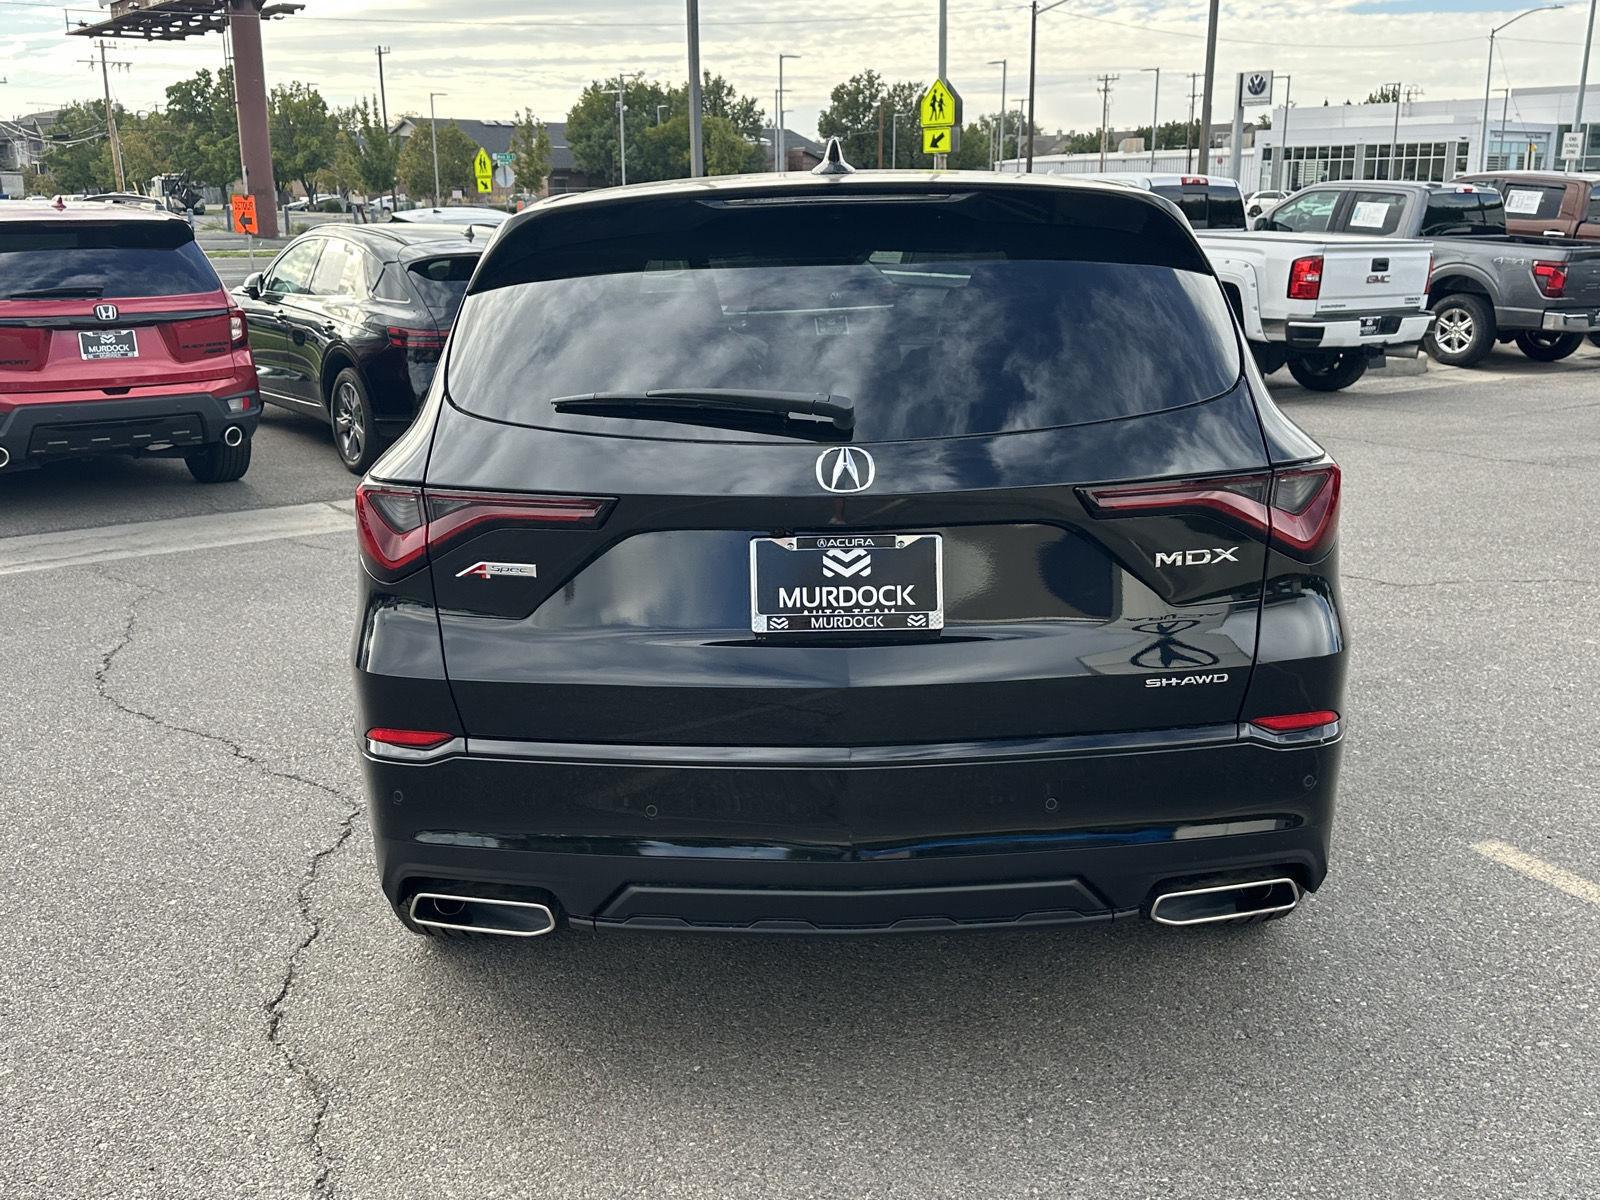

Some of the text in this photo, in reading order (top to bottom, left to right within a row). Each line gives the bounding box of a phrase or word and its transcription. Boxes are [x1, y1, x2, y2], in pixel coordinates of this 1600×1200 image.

[234, 201, 254, 210] DETOUR
[1366, 275, 1391, 284] GMC
[88, 344, 130, 353] MURDOCK
[827, 538, 874, 547] ACURA
[1155, 546, 1239, 568] MDX
[778, 584, 916, 608] MURDOCK
[810, 616, 884, 629] MURDOCK
